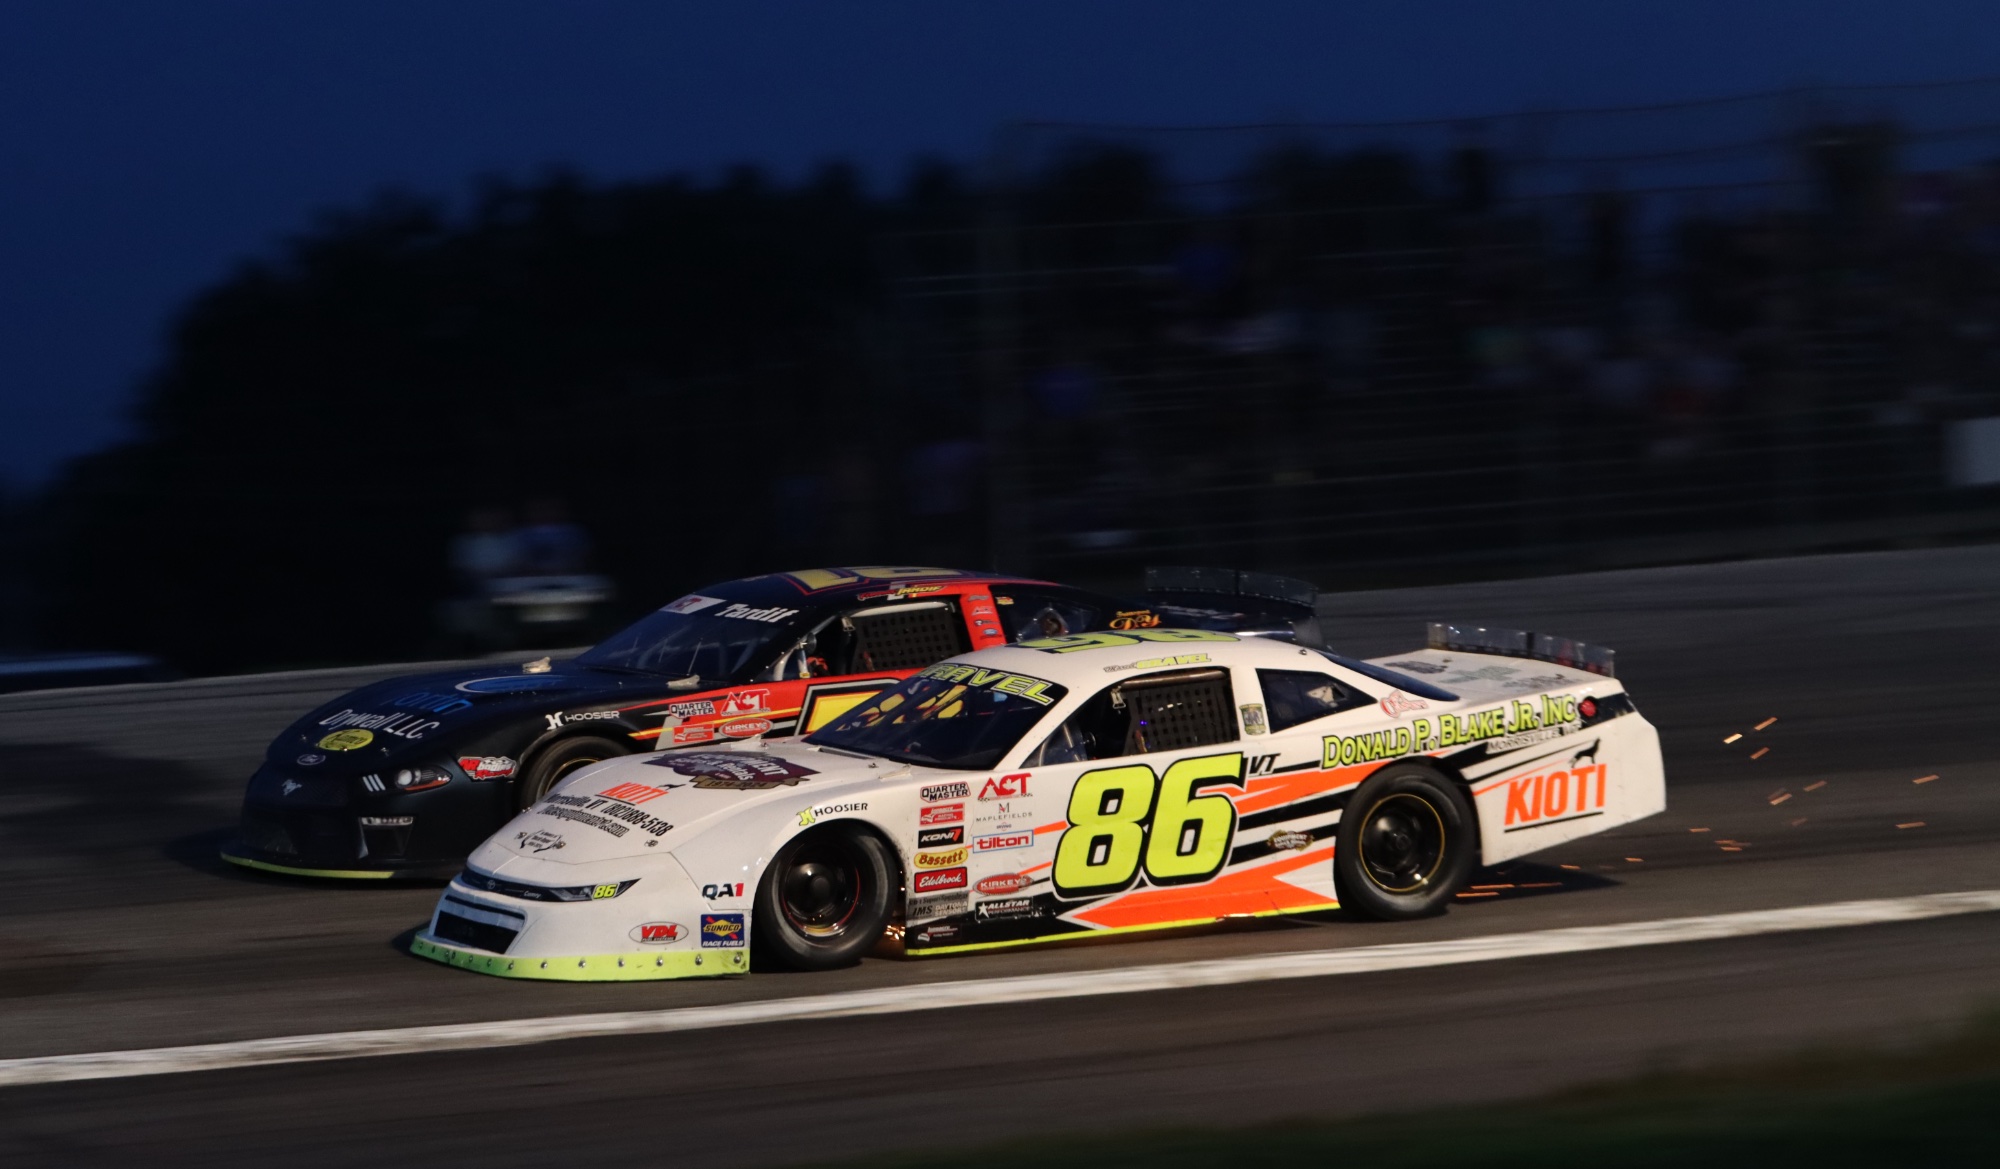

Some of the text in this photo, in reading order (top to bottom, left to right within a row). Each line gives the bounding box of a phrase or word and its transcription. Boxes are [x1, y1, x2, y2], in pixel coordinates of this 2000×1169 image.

[714, 603, 800, 623] Tardif
[671, 702, 711, 713] QUARTER
[721, 689, 770, 713] ACT
[565, 710, 620, 723] HOOSIER
[679, 707, 714, 717] MASTER
[318, 708, 440, 739] Drywall LLC
[725, 723, 761, 731] KIRKEY
[1322, 694, 1576, 770] DONALD P. BLAKE JR. INC
[1250, 753, 1280, 774] VT
[922, 783, 967, 798] QUARTER
[978, 772, 1031, 799] ACT
[598, 782, 669, 805] KIOTI
[929, 788, 968, 801] MASTER
[1503, 764, 1607, 825] KIOTI
[585, 798, 608, 809] VT
[601, 803, 674, 836] (802)888-5138
[814, 802, 868, 817] HOOSIER
[976, 812, 1033, 822] MAPLEFIELDS
[1052, 751, 1245, 898] 86
[920, 831, 954, 843] KONI
[977, 835, 1029, 849] tilton
[918, 849, 964, 866] Bassett
[919, 872, 962, 888] Edelbrock
[980, 877, 1021, 888] KIRKEY
[593, 884, 617, 899] 86
[702, 883, 744, 900] QA1
[912, 905, 932, 916] IMS
[987, 899, 1030, 909] ALLSTAR
[641, 925, 678, 938] VDL
[705, 924, 740, 932] SUNOCO
